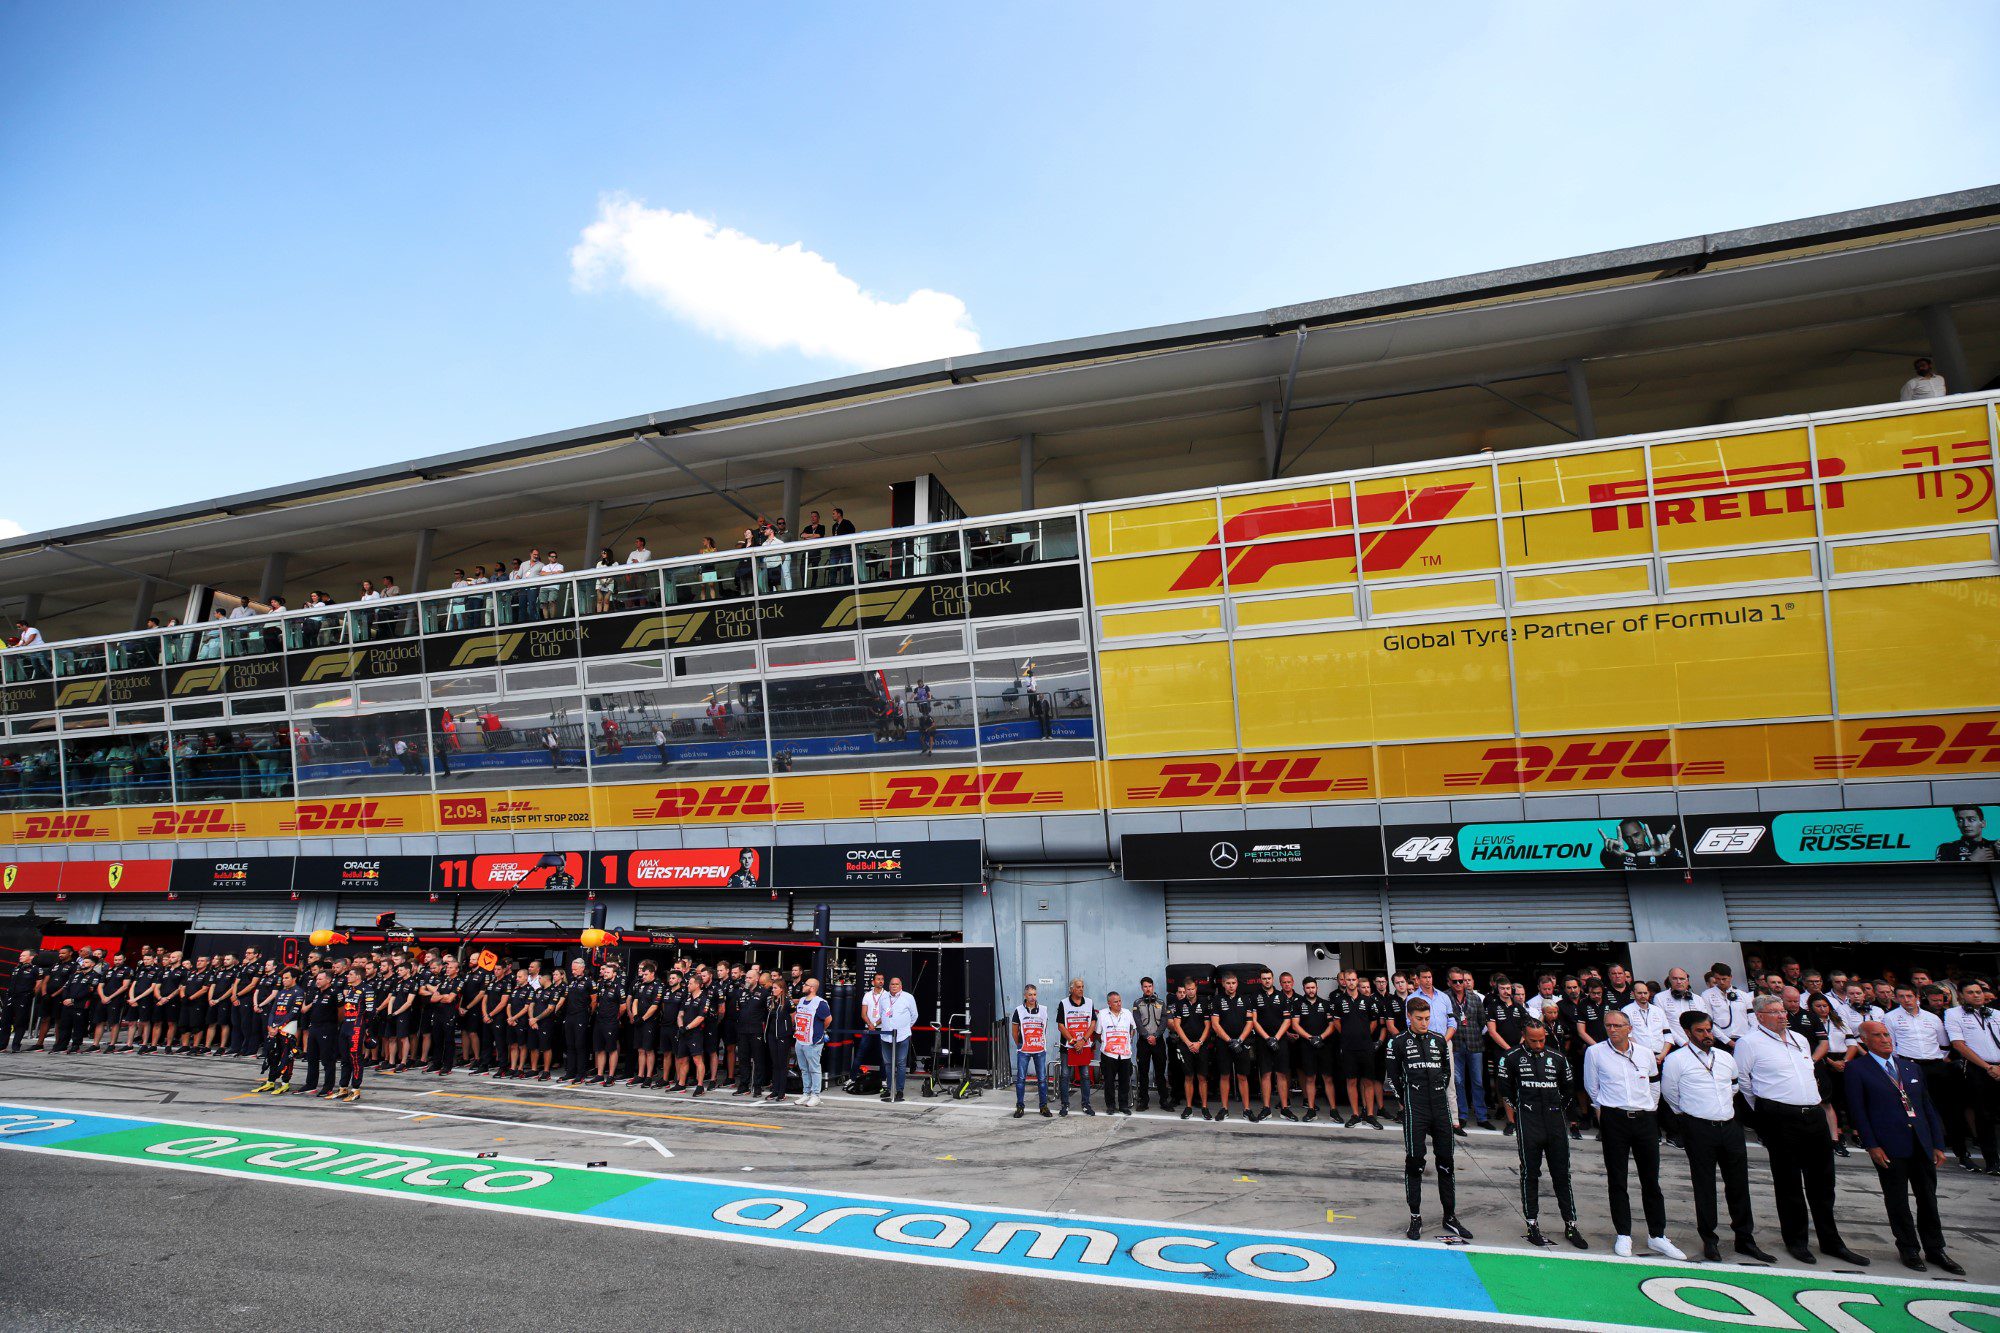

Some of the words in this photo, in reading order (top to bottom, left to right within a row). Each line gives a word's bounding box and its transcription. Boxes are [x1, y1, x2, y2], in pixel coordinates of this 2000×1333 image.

[1588, 457, 1846, 533] PIRELLI
[930, 578, 1012, 601] Paddock
[715, 603, 784, 625] Paddock
[932, 598, 972, 617] Club
[530, 625, 590, 644] Paddock
[716, 622, 751, 639] Club
[1383, 630, 1455, 651] Global
[1461, 628, 1517, 649] Tyre
[1524, 618, 1616, 640] Partner
[1622, 614, 1649, 634] of
[1656, 607, 1763, 631] Formula
[370, 645, 421, 662] Paddock
[531, 642, 561, 658] Club
[233, 660, 279, 677] Paddock
[371, 660, 397, 675] Club
[109, 675, 151, 691] Paddock
[234, 674, 257, 688] Club
[110, 689, 132, 700] Club
[1479, 738, 1684, 785] DHL
[1158, 757, 1333, 798] DHL
[886, 772, 1034, 809] DHL
[497, 801, 533, 812] DHL
[652, 785, 779, 818] DHL
[295, 802, 384, 831] DHL
[443, 804, 483, 819] 2.09s
[490, 815, 527, 824] FASTEST
[528, 815, 542, 823] PIT
[544, 814, 567, 822] STOP
[568, 813, 589, 821] 2022
[25, 815, 96, 838] DHL
[152, 809, 230, 835] DHL
[1801, 823, 1864, 835] GEORGE
[1474, 835, 1515, 846] LEWIS
[1694, 825, 1766, 854] 63
[1799, 833, 1911, 852] RUSSELL
[846, 850, 901, 860] ORACLE
[1244, 850, 1302, 858] PETRONAS
[1392, 836, 1454, 862] 44
[1471, 843, 1593, 861] HAMILTON
[215, 863, 248, 871] ORACLE
[343, 861, 380, 870] ORACLE
[491, 863, 518, 871] SERGIO
[600, 855, 618, 884] 1
[638, 859, 660, 867] MAX
[439, 860, 468, 888] 11
[488, 870, 529, 882] PEREZ
[636, 866, 730, 879] VERSTAPPEN
[143, 1136, 554, 1193] aramco
[711, 1197, 1337, 1283] aramco
